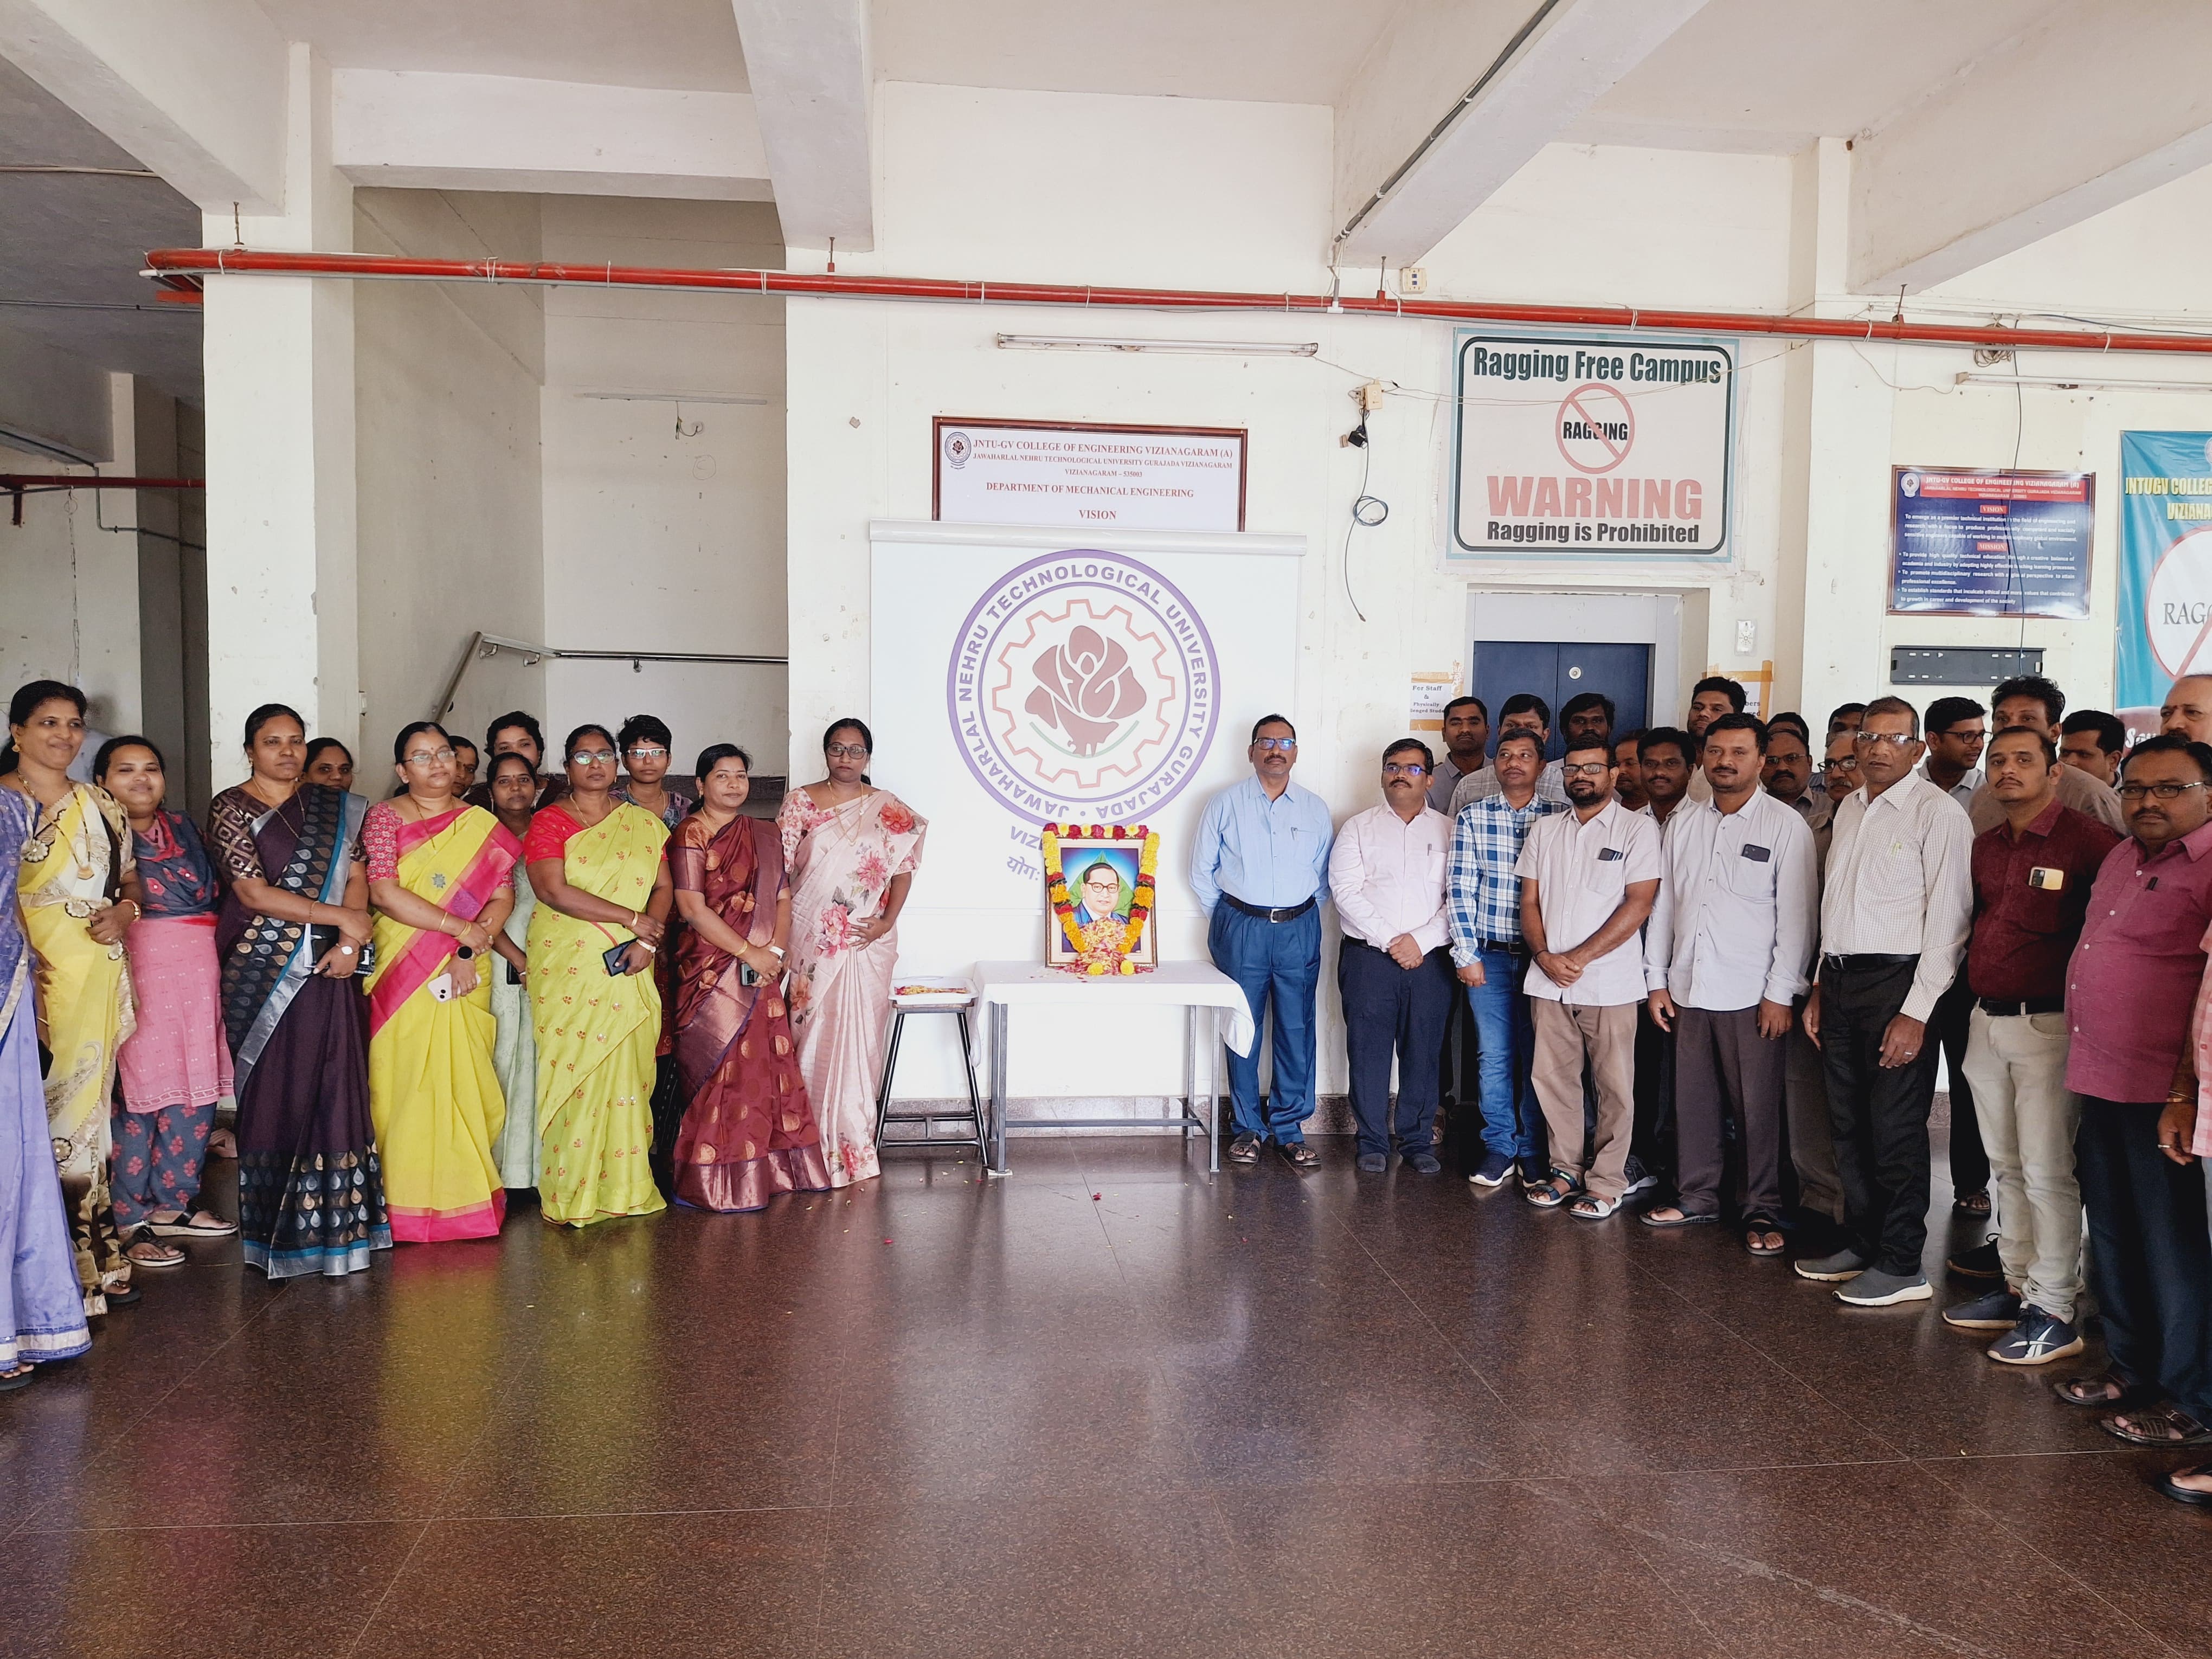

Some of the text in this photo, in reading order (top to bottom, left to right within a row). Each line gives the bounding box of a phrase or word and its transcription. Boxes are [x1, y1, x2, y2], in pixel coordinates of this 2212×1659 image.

[1474, 348, 1721, 383] Ragging Free Campus
[973, 439, 1233, 459] JNTU-GV COLLEGE OF ENGINEERING VIZIANAGARAM (A)
[1045, 456, 1102, 465] TECHNOLOGICAL
[1103, 458, 1143, 466] UNIVERSITY
[1181, 461, 1232, 469] VIZIANAGARAM
[1065, 468, 1117, 477] VIZIANAGARAM
[986, 482, 1194, 498] DEPARTMENT OF MECHANICAL ENGINEERING
[2125, 477, 2169, 494] JNTUGV
[1487, 476, 1701, 520] WARNING
[1078, 510, 1116, 519] VISION
[1488, 522, 1699, 543] Ragging is Prohibited
[959, 564, 1208, 819] JAWAHARLAL NEHRU TECHNOLOGICAL UNIVERSITY GURAJADA
